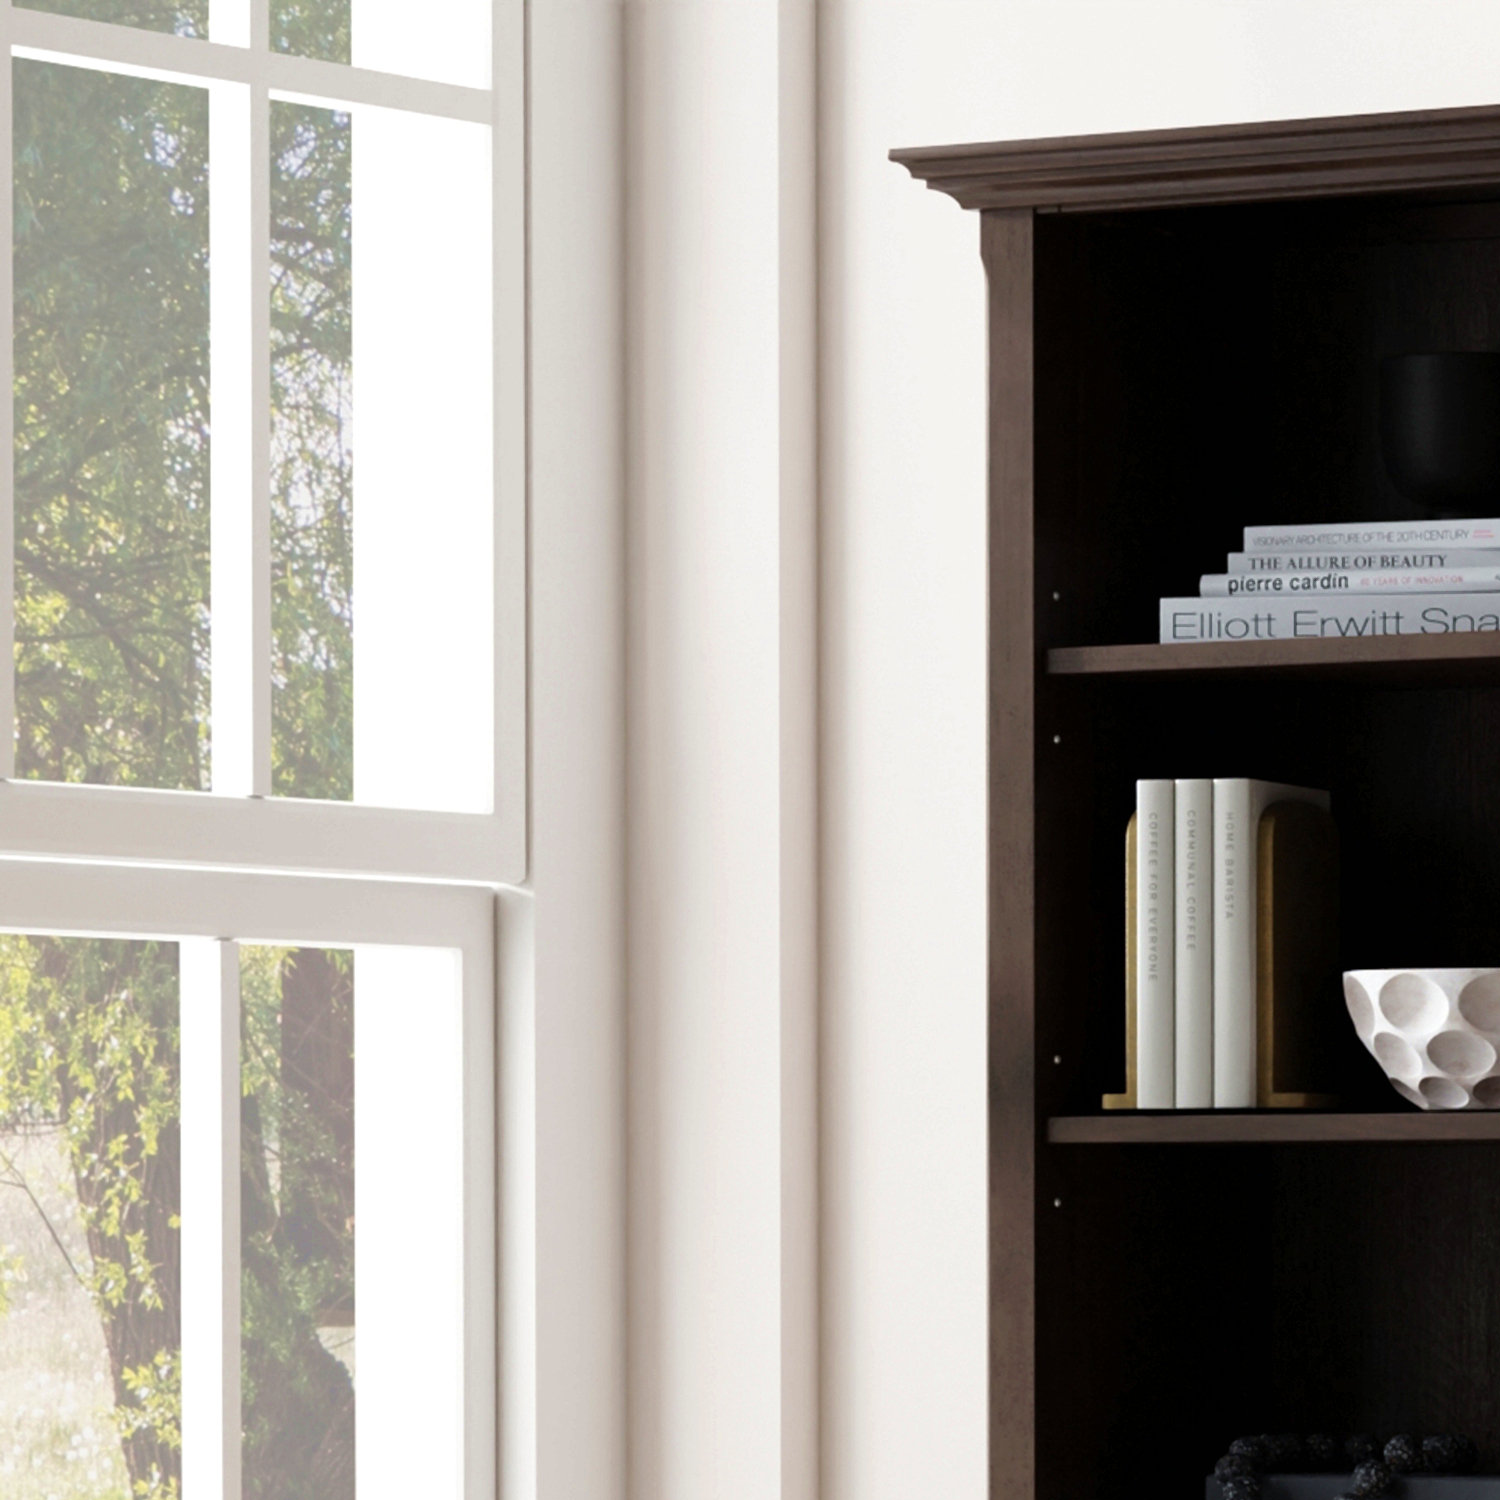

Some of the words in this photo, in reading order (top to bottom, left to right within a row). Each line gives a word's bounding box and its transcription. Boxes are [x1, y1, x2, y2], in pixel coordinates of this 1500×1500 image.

[1296, 532, 1358, 545] ARCHITECTURE
[1362, 531, 1374, 543] OF
[1375, 530, 1395, 542] THE
[1423, 528, 1472, 541] CENTURY
[1249, 557, 1282, 571] THE
[1286, 556, 1351, 570] ALLURE
[1354, 555, 1377, 569] OF
[1380, 554, 1448, 568] BEAUTY
[1227, 573, 1283, 596] pierre
[1289, 573, 1350, 591] cardin
[1172, 611, 1277, 640] Elliott
[1293, 609, 1405, 638] Erwitt
[1148, 811, 1158, 866] COFFEE
[1186, 809, 1197, 888] COMMUNAL
[1225, 811, 1235, 851] HOME
[1148, 872, 1158, 900] FOR
[1225, 857, 1235, 920] BARISTA
[1186, 896, 1197, 951] COFFEE
[1148, 908, 1158, 982] EVERYONE
